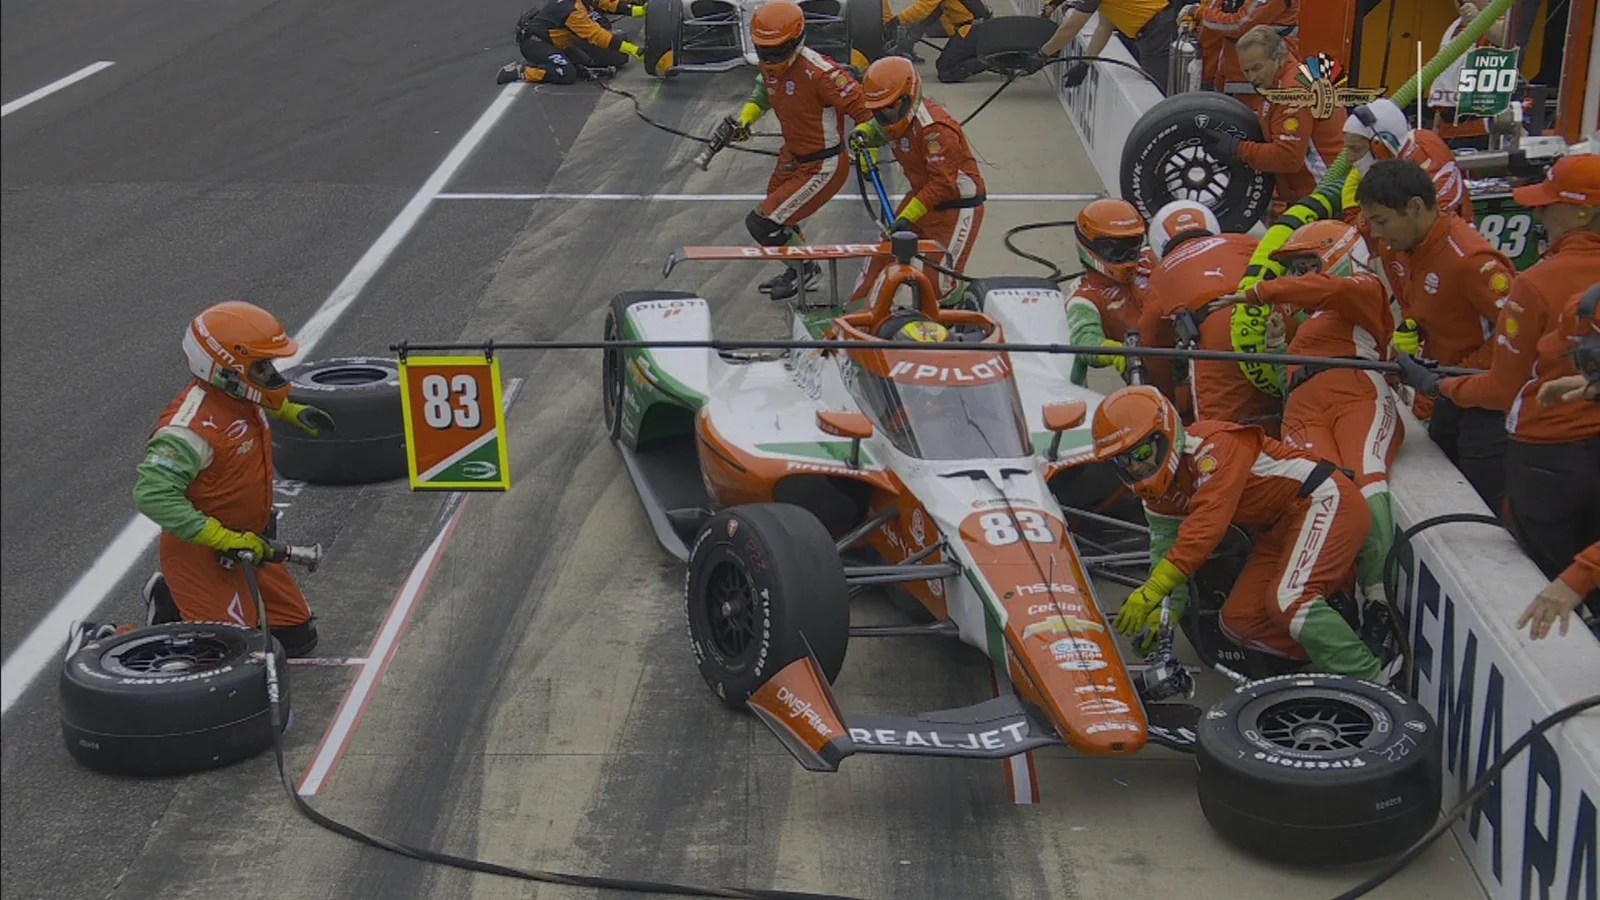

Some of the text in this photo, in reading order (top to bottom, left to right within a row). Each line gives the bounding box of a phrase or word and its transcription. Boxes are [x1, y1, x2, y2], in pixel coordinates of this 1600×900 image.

[1480, 214, 1531, 258] 83
[422, 374, 482, 429] 83
[1371, 395, 1394, 460] PREMA
[979, 511, 1054, 546] 83
[1287, 494, 1334, 590] PREMA
[754, 588, 771, 678] Firestone
[1254, 752, 1366, 770] Firestone
